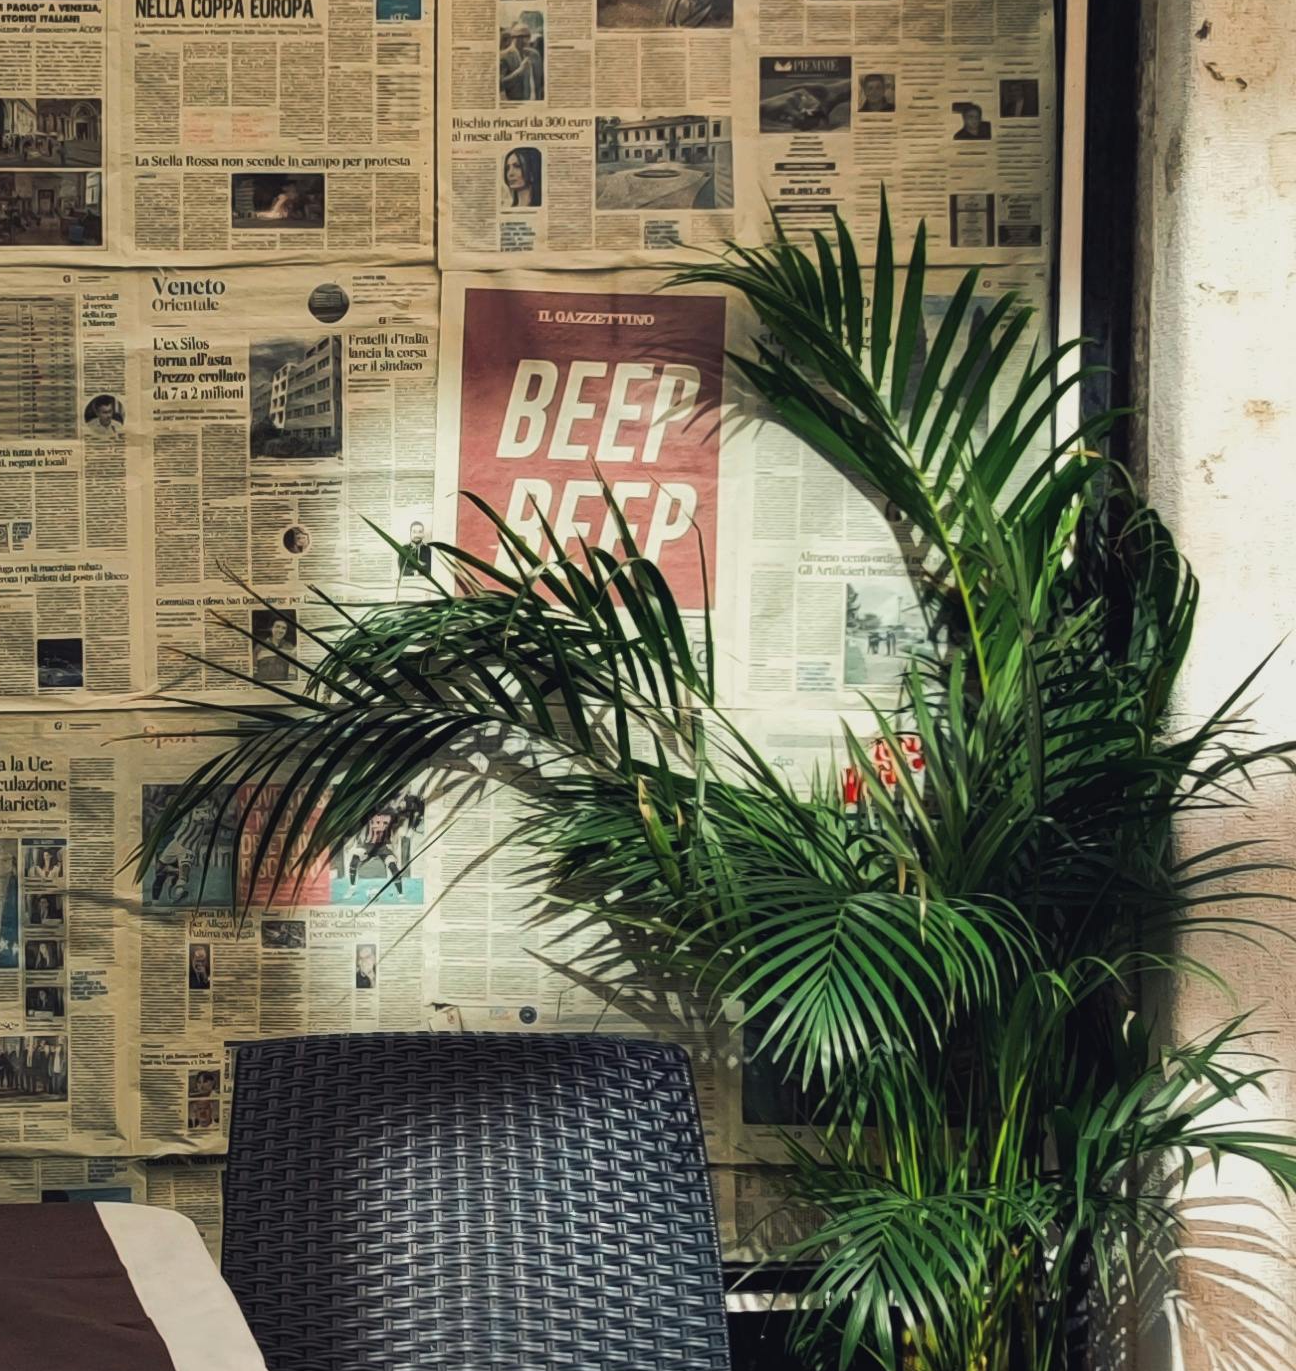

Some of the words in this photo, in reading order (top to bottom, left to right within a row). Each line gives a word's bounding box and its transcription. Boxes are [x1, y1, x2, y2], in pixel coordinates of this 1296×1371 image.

[136, 156, 149, 166] La
[151, 155, 183, 166] Stella
[186, 156, 219, 166] Rossa
[222, 158, 244, 167] non
[246, 155, 285, 166] scende
[288, 156, 299, 167] in
[300, 158, 340, 168] campo
[343, 158, 362, 169] per
[364, 158, 410, 169] protesta
[152, 277, 225, 295] Veneto
[152, 298, 219, 311] Orientale
[538, 310, 554, 322] IL
[555, 311, 654, 325] GAZZETTINO
[154, 338, 178, 350] L'ex
[180, 337, 209, 350] Silos
[154, 356, 188, 367] torna
[190, 353, 232, 366] all'asta
[154, 371, 196, 383] Prezzo
[198, 369, 246, 382] crollato
[153, 386, 169, 400] da
[171, 387, 178, 400] 7
[181, 390, 188, 400] a
[191, 386, 198, 402] 2
[201, 386, 243, 399] milioni
[495, 359, 702, 463] BEEP
[10, 755, 24, 772] la
[28, 756, 52, 772] Ue:
